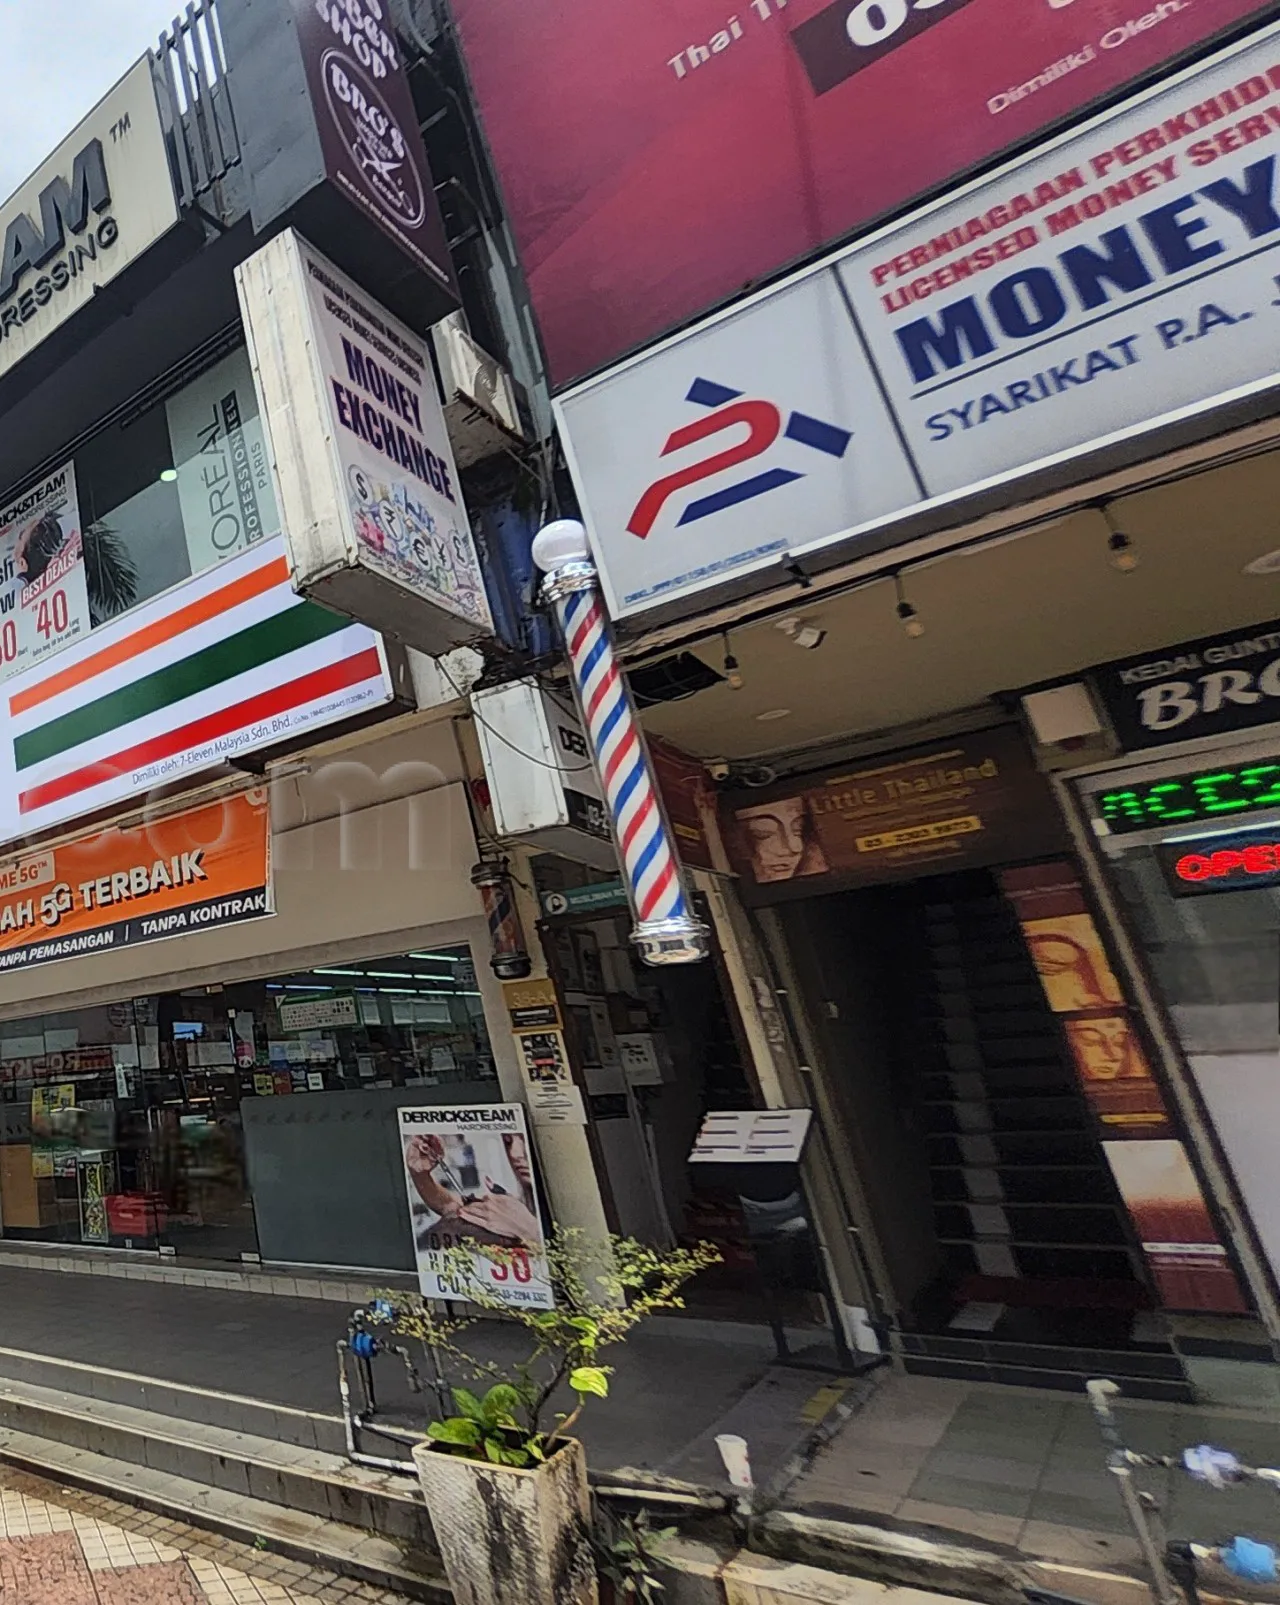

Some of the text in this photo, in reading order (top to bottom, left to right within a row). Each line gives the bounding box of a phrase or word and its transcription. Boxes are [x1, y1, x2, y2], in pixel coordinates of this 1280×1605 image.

[666, 14, 741, 81] Thai
[985, 44, 1096, 115] Dimiliki
[870, 165, 1087, 288] PERNIAGAAN
[880, 223, 1041, 315] LICENSED
[1047, 153, 1180, 237] MONEY
[893, 152, 1280, 385] MONEY
[339, 332, 425, 437] MONEY
[923, 303, 1258, 442] SYARIKAT P.A.
[226, 396, 262, 542] ROFESSIONNEL
[250, 441, 268, 490] PARIS
[329, 375, 457, 507] EXCHANGE
[22, 573, 46, 604] BEST
[37, 589, 68, 640] 40
[132, 764, 160, 785] Dimiliki
[180, 746, 214, 767] 7-Eleven
[214, 732, 251, 754] Malaysia
[39, 882, 74, 928] 5G
[79, 847, 209, 910] TERBAIK
[28, 929, 116, 963] PEMASANGAN
[140, 913, 188, 937] TANPA
[188, 892, 267, 926] KONTRAK
[402, 1109, 516, 1124] DERRICK&TEAM
[457, 1123, 518, 1131] HAIRDRESSING
